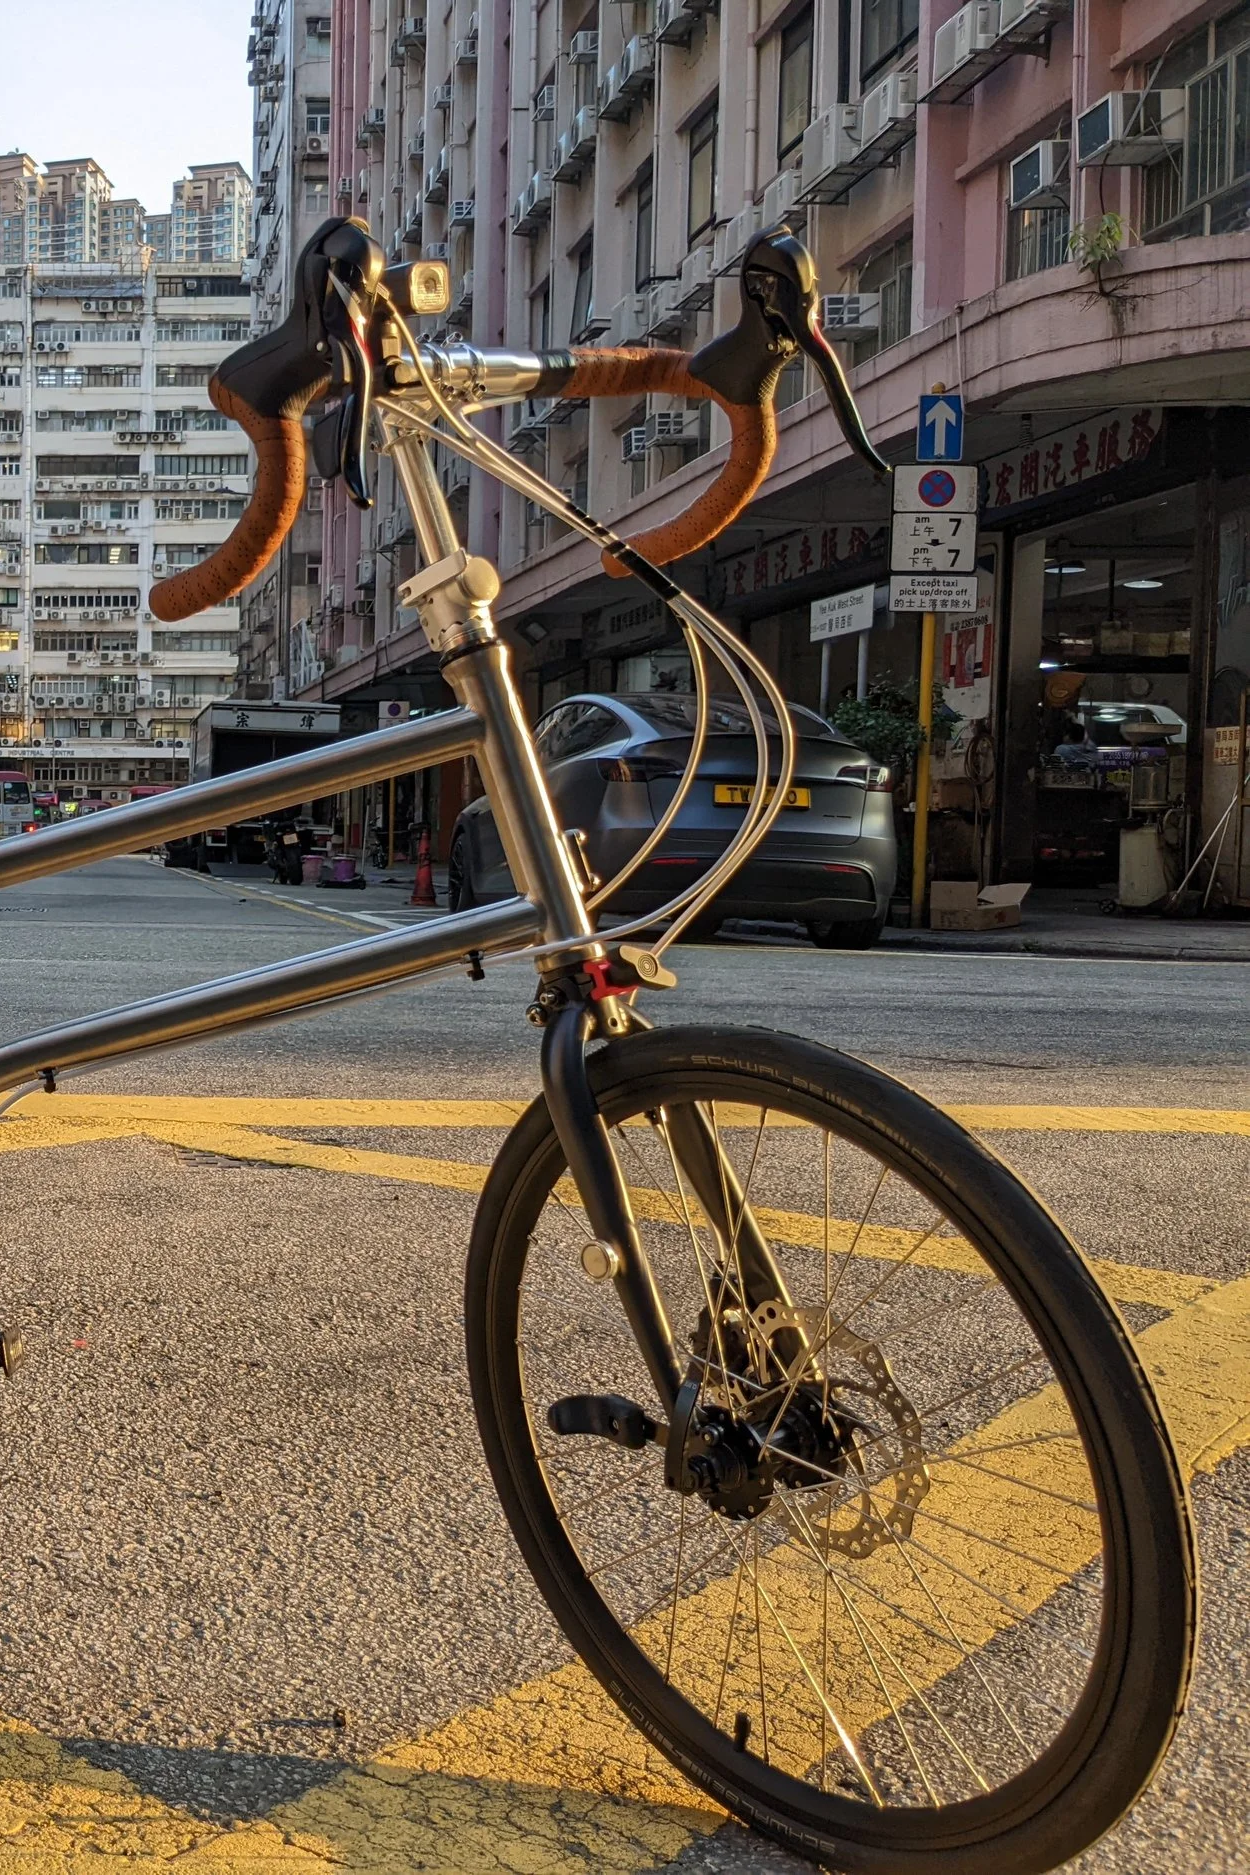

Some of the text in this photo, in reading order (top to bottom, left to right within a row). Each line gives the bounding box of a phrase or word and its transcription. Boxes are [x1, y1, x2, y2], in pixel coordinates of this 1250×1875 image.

[915, 516, 930, 524] am
[909, 526, 935, 537] 上午
[949, 518, 962, 537] 7
[913, 547, 929, 556] pm
[908, 557, 933, 568] 下午
[947, 549, 961, 568] 7
[910, 579, 959, 588] Except taxi
[899, 588, 968, 597] pick up/drop off
[818, 604, 827, 615] Yee
[837, 599, 848, 610] West
[849, 594, 864, 607] Street
[894, 599, 972, 609] 的士上落客除外
[690, 1055, 823, 1097] SCHWALBE
[609, 1680, 645, 1722] ONE
[712, 1779, 836, 1854] SCHWALBE
